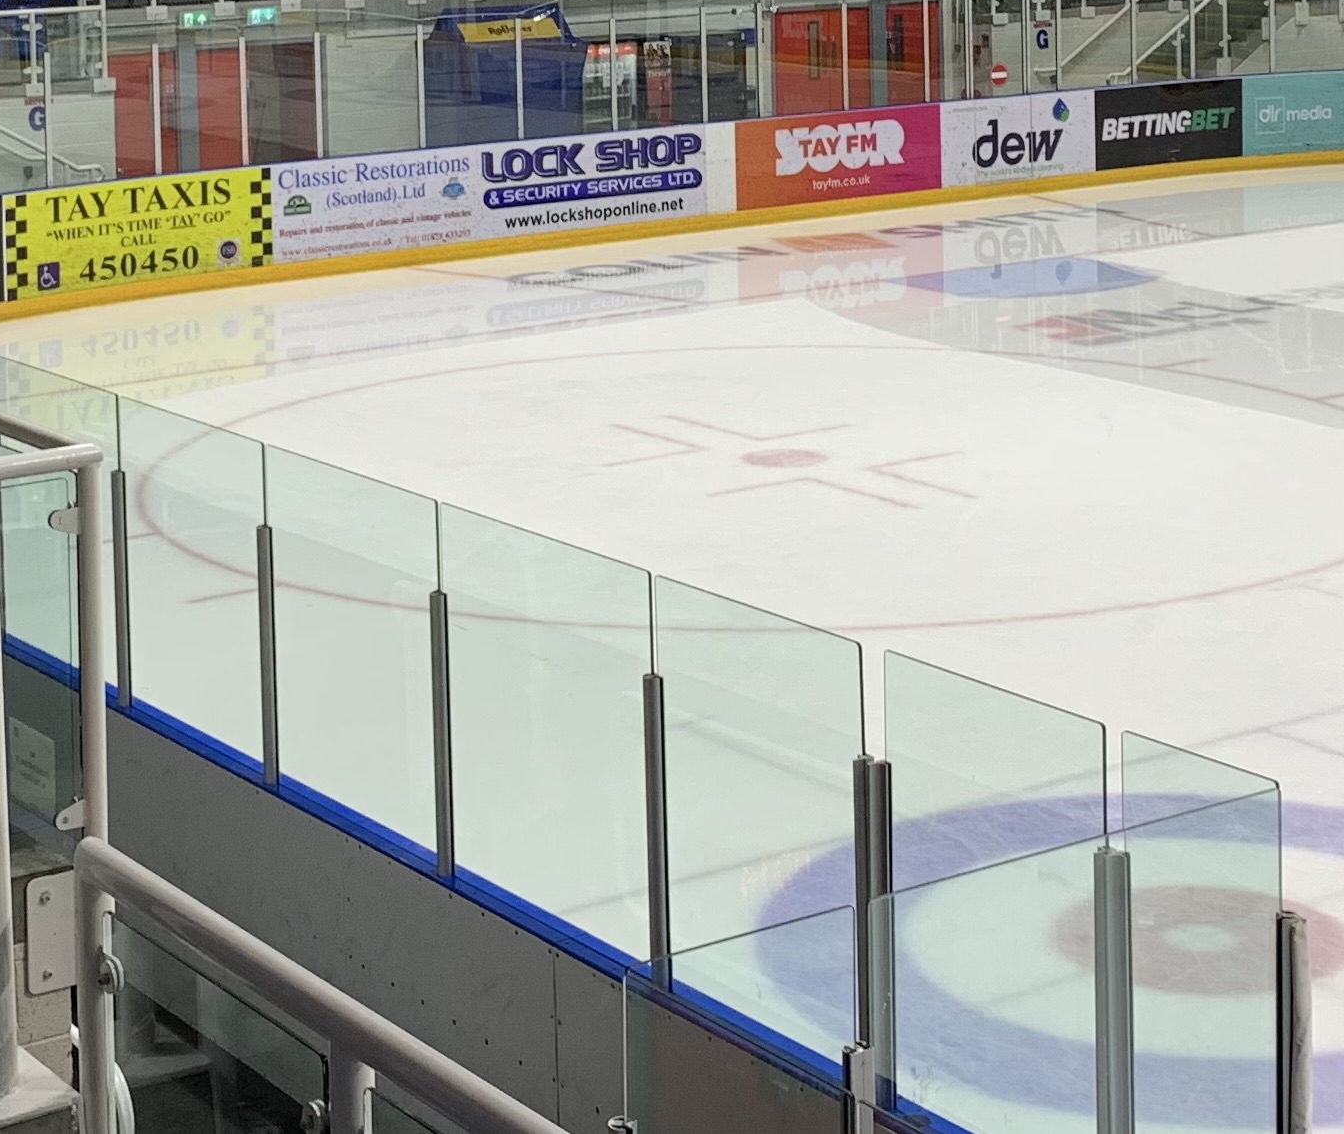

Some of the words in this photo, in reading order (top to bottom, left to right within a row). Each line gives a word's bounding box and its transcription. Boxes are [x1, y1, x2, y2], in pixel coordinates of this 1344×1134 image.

[1036, 29, 1049, 50] G
[1287, 105, 1332, 121] media
[481, 143, 585, 183] LOCK
[595, 133, 702, 173] SHOP
[799, 137, 839, 157] TAY
[846, 133, 878, 153] FM
[972, 119, 1063, 168] dew
[278, 165, 348, 190] Classic
[355, 156, 471, 182] Restorations
[812, 175, 871, 191] tayfm.co.uk
[46, 190, 113, 224] TAY
[123, 178, 231, 214] TAXIS
[326, 187, 397, 208] (Scotland)
[402, 183, 426, 199] Ltd
[489, 191, 500, 205] &
[503, 183, 582, 203] SECURITY
[587, 175, 662, 194] SERVICES
[668, 172, 697, 186] LTD.
[126, 218, 162, 233] TIME
[279, 227, 307, 238] Repairs
[310, 225, 323, 234] and
[366, 218, 374, 227] of
[376, 216, 399, 227] classic
[444, 209, 472, 219] vehicles
[505, 197, 684, 229] www.lockshoponline.net
[120, 235, 157, 248] CALL
[79, 245, 199, 282] 450450
